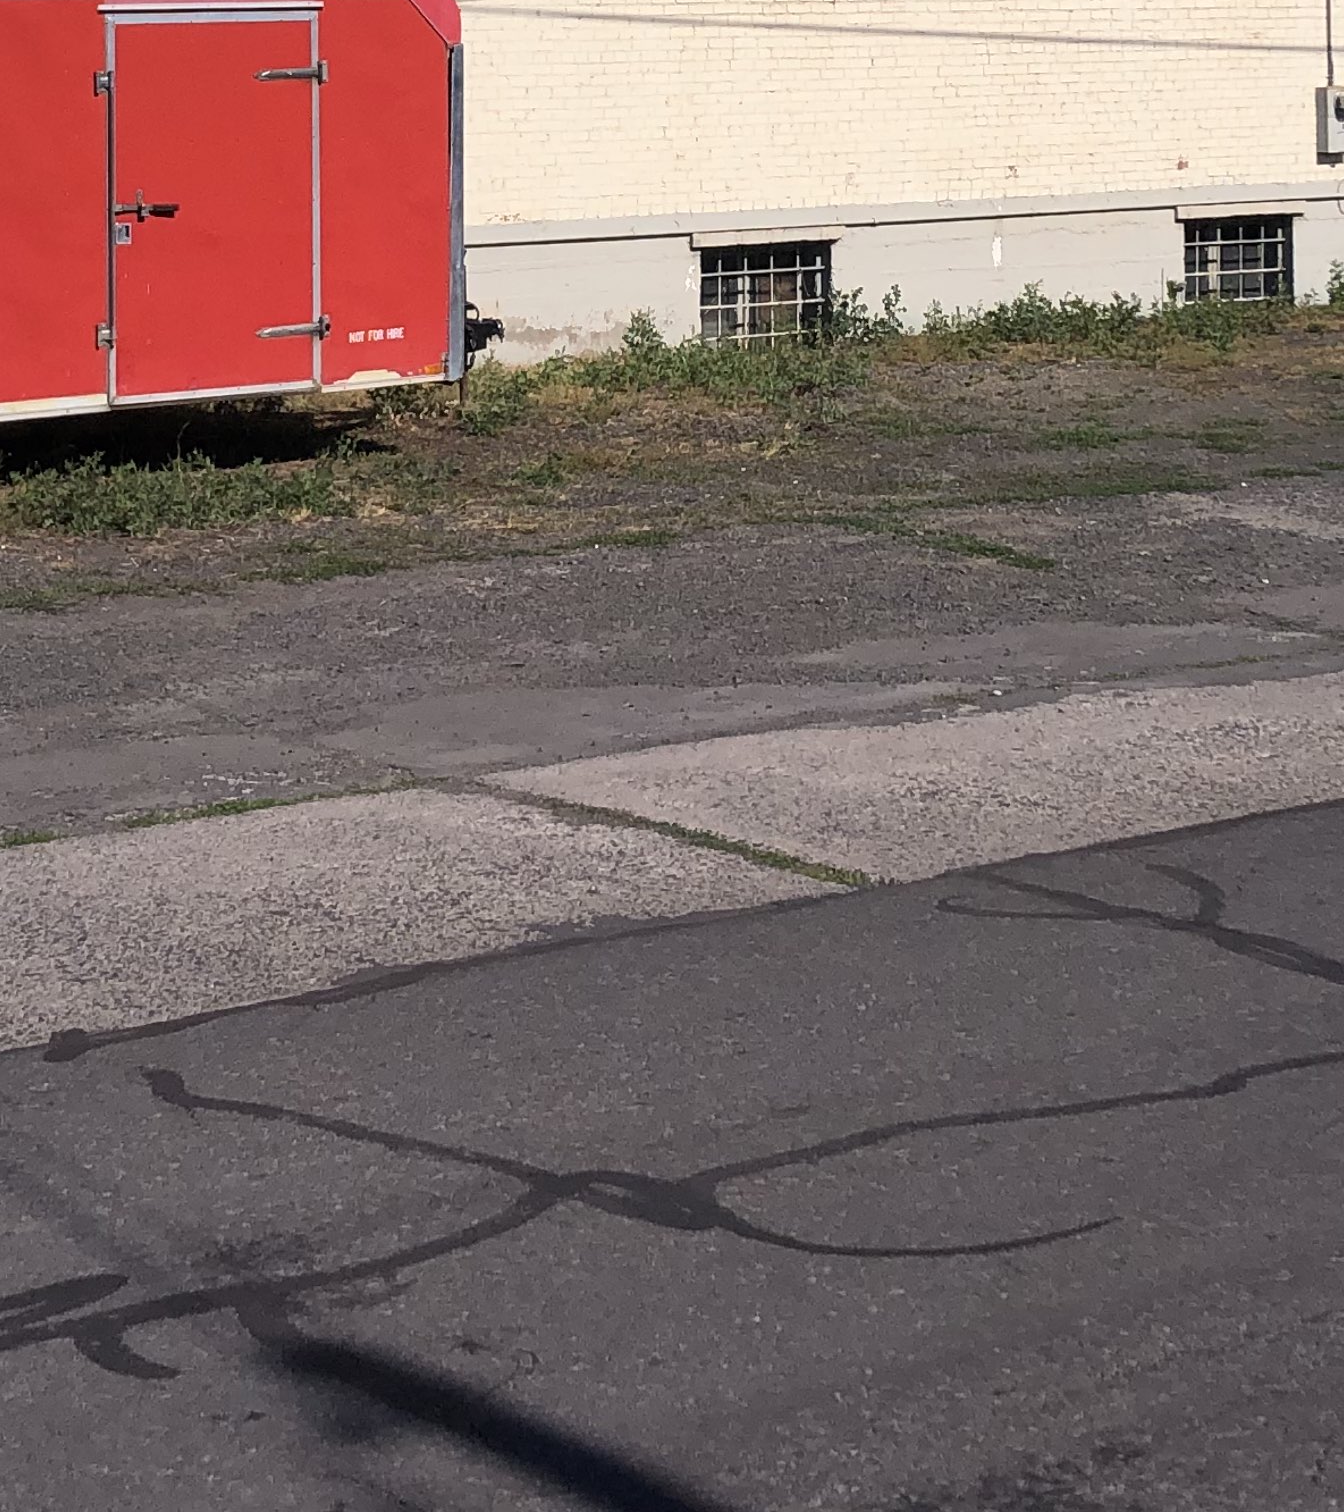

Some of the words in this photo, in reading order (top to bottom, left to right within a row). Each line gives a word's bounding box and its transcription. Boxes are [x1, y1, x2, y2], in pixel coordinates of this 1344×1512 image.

[349, 331, 365, 343] NOT
[368, 329, 384, 341] FOR
[387, 327, 404, 339] HIRE
